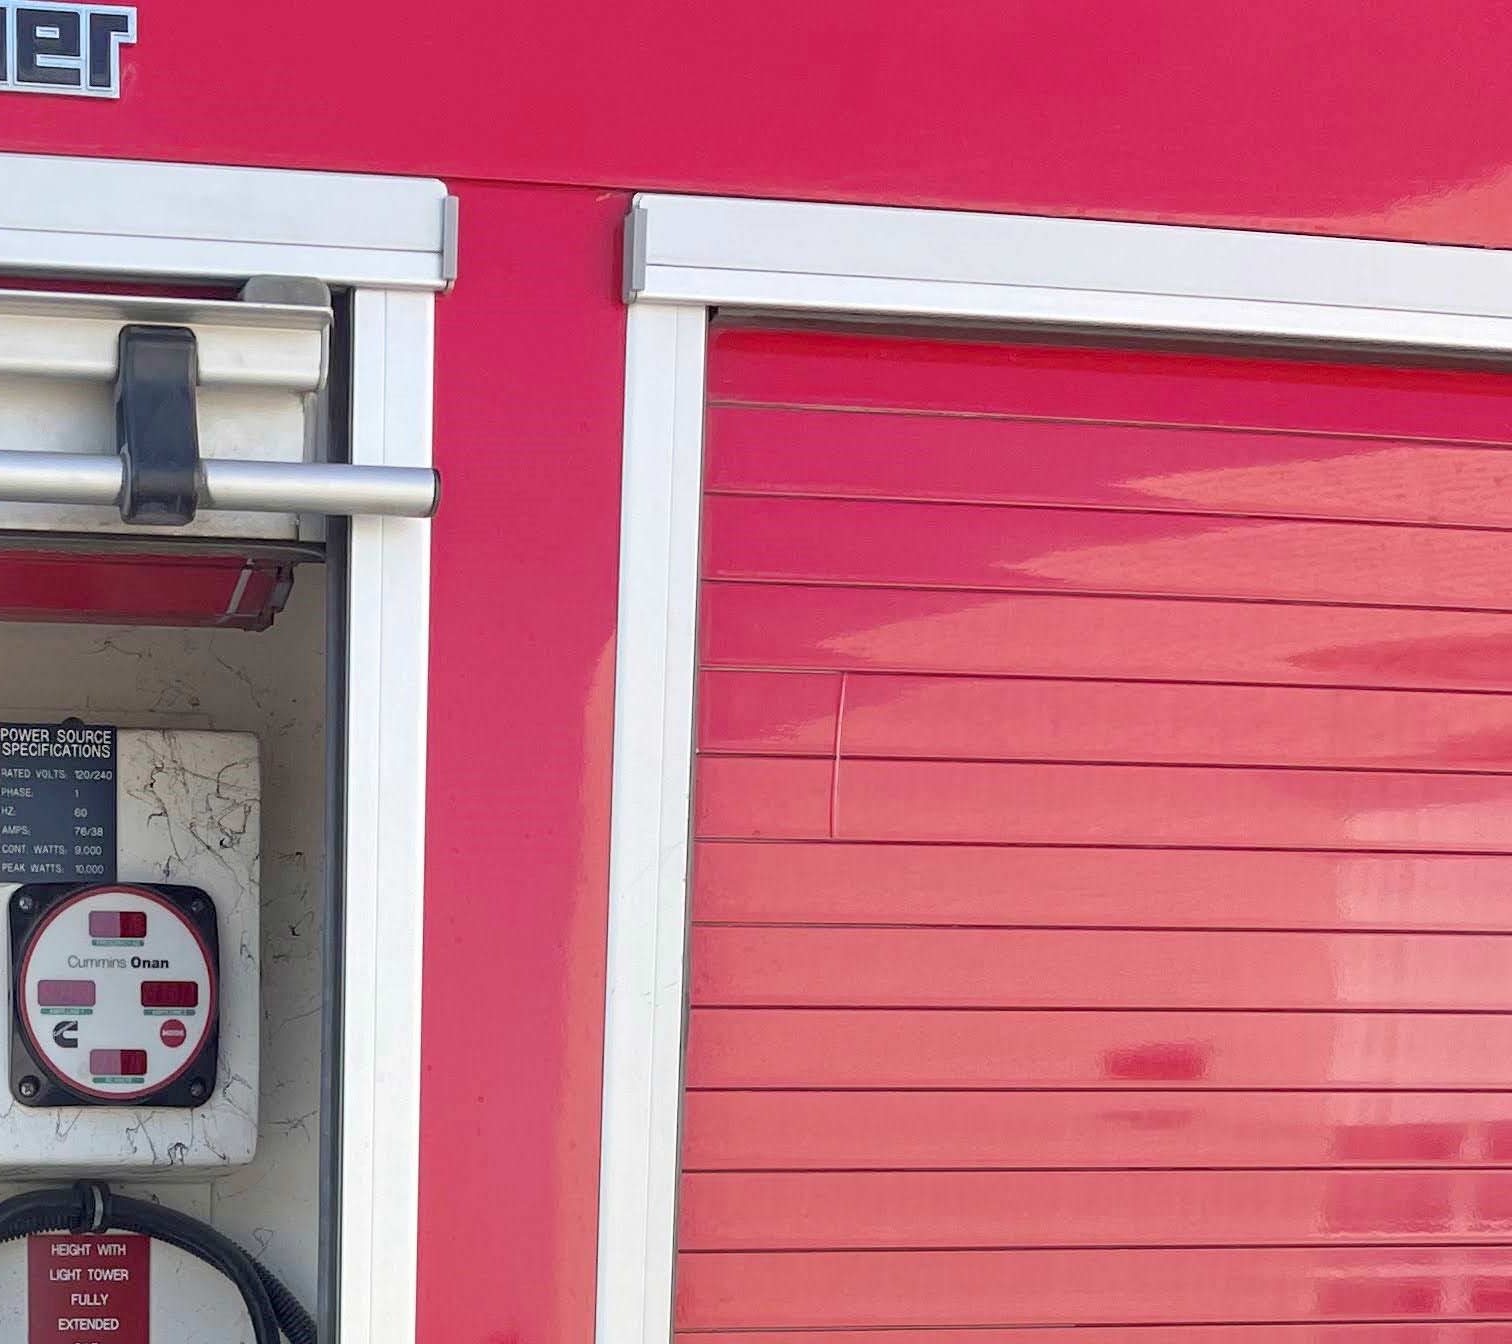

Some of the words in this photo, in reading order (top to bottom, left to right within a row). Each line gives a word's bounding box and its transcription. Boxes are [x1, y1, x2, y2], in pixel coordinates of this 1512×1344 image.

[0, 727, 50, 742] POWER
[57, 729, 112, 745] SOURCE
[2, 742, 111, 759] SPECIFICATIONS
[0, 768, 31, 779] RATED
[74, 770, 113, 781] 120/240
[74, 808, 88, 818] 60
[74, 826, 104, 837] 76/38
[1, 862, 26, 873] PEAK
[67, 954, 128, 969] Cummins
[130, 956, 170, 969] Onan
[51, 1243, 91, 1256] HEIGHT
[96, 1243, 126, 1256] WITH
[49, 1268, 82, 1281] LIGHT
[87, 1268, 129, 1281] TOWER
[70, 1293, 109, 1306] FULLY
[57, 1318, 120, 1331] EXTENDED
